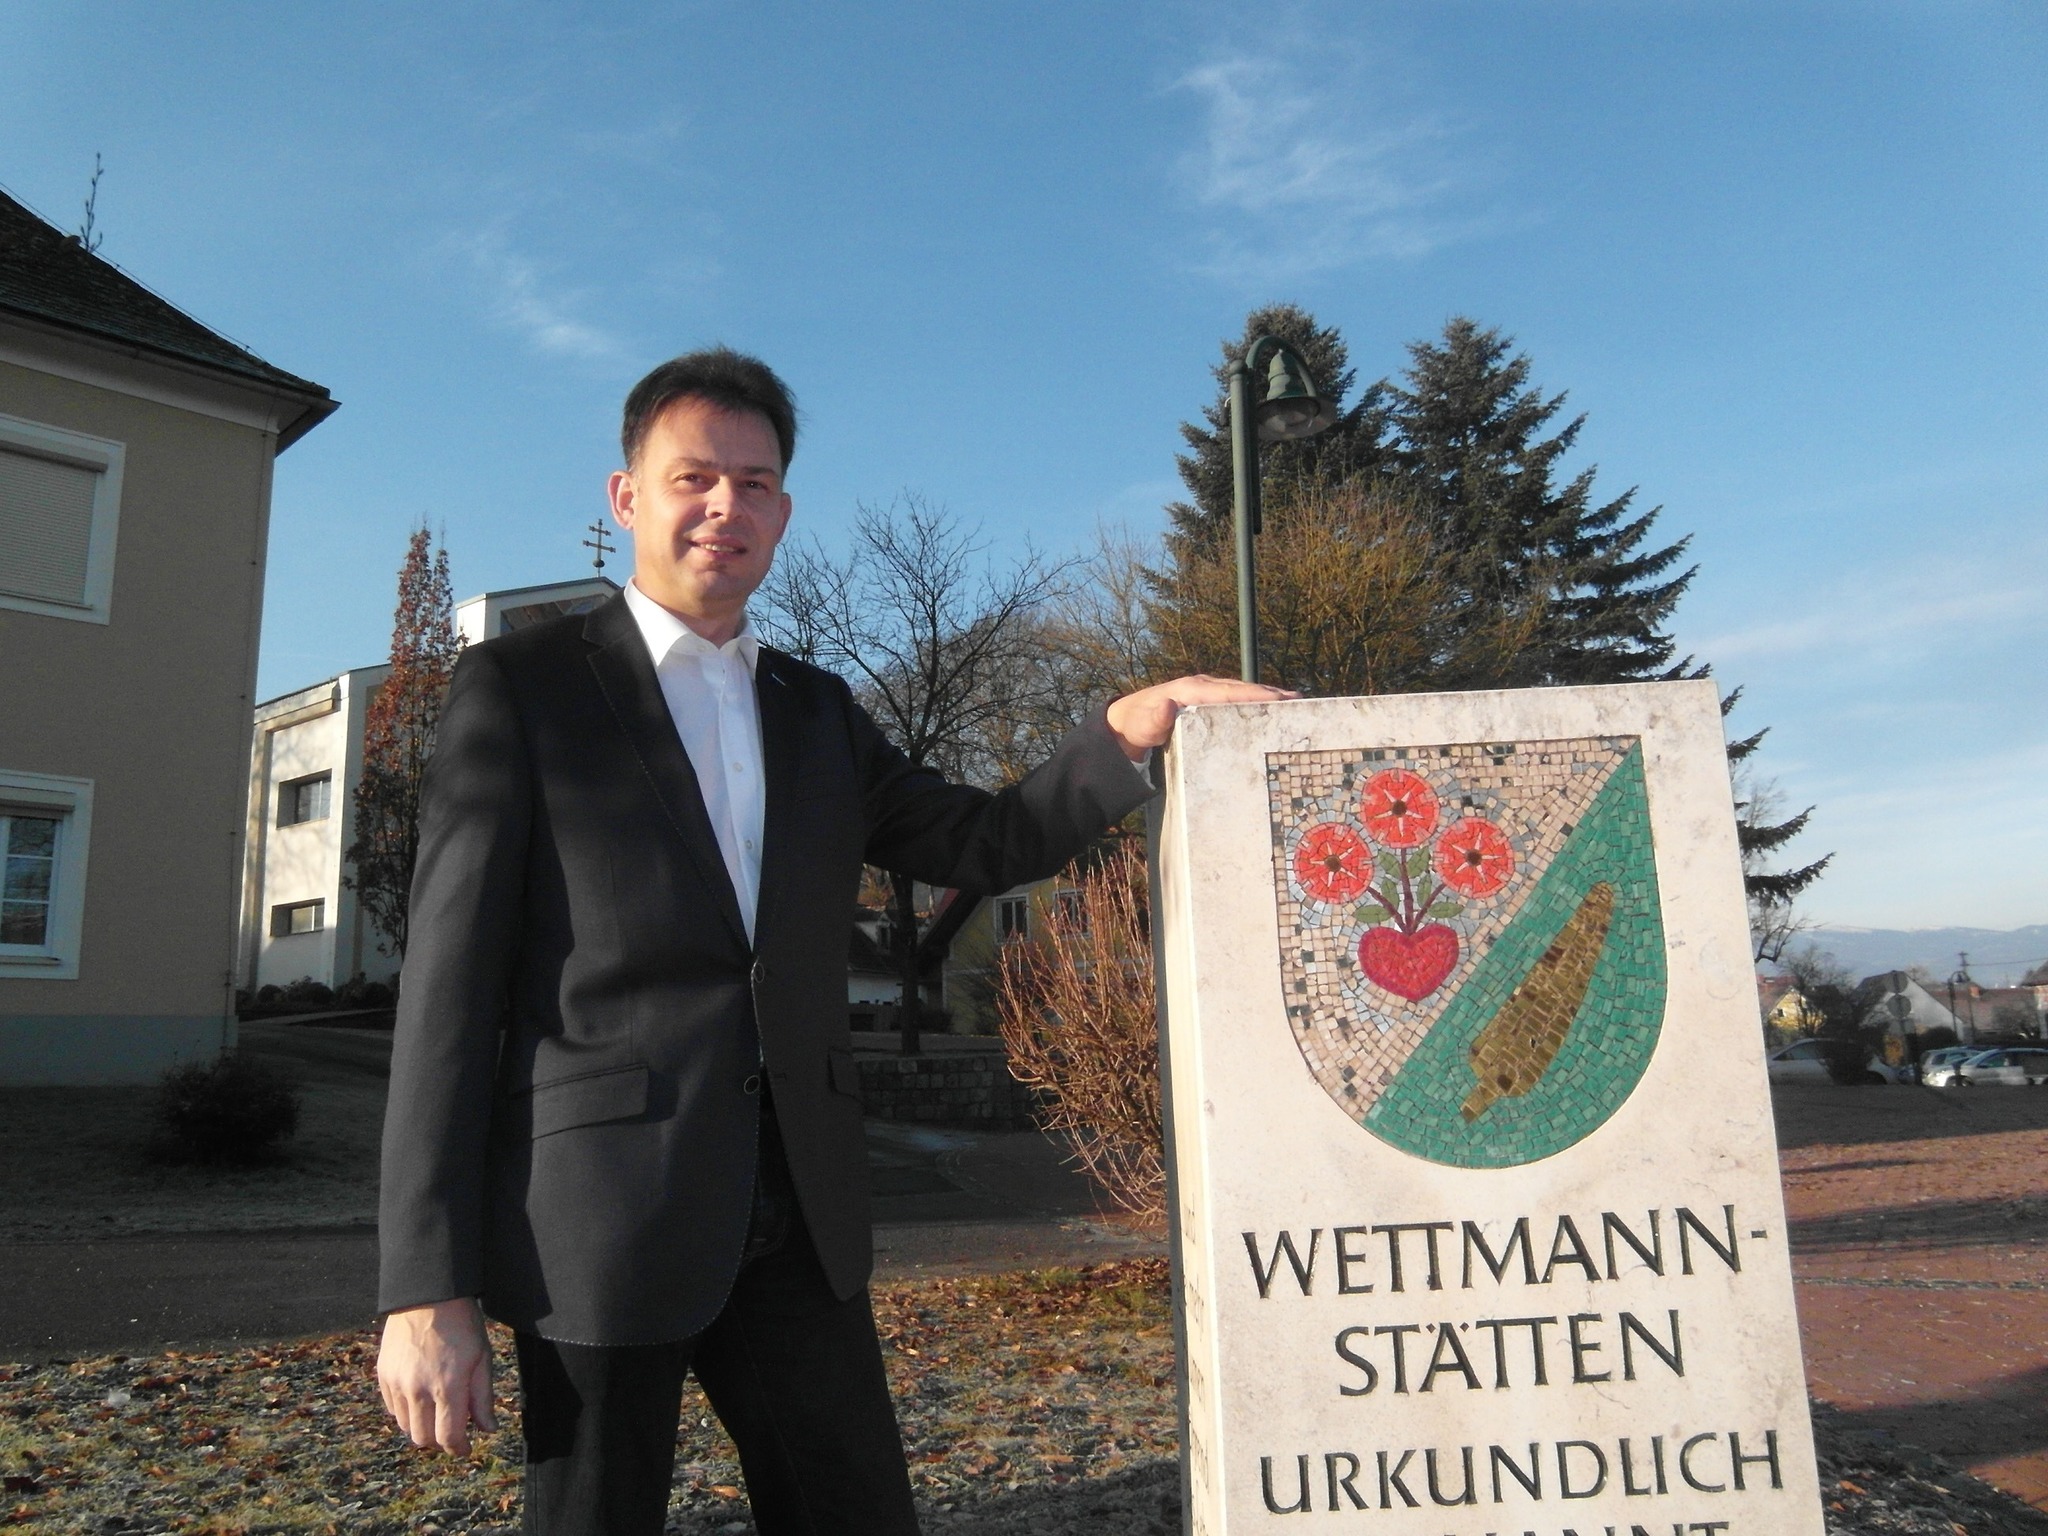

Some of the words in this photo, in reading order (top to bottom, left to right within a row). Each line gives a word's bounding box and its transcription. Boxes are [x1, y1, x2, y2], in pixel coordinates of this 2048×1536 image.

[1241, 1204, 1767, 1299] WETTMANN-
[1334, 1309, 1685, 1397] STÄTTEN
[1260, 1429, 1784, 1515] URKUNDLICH
